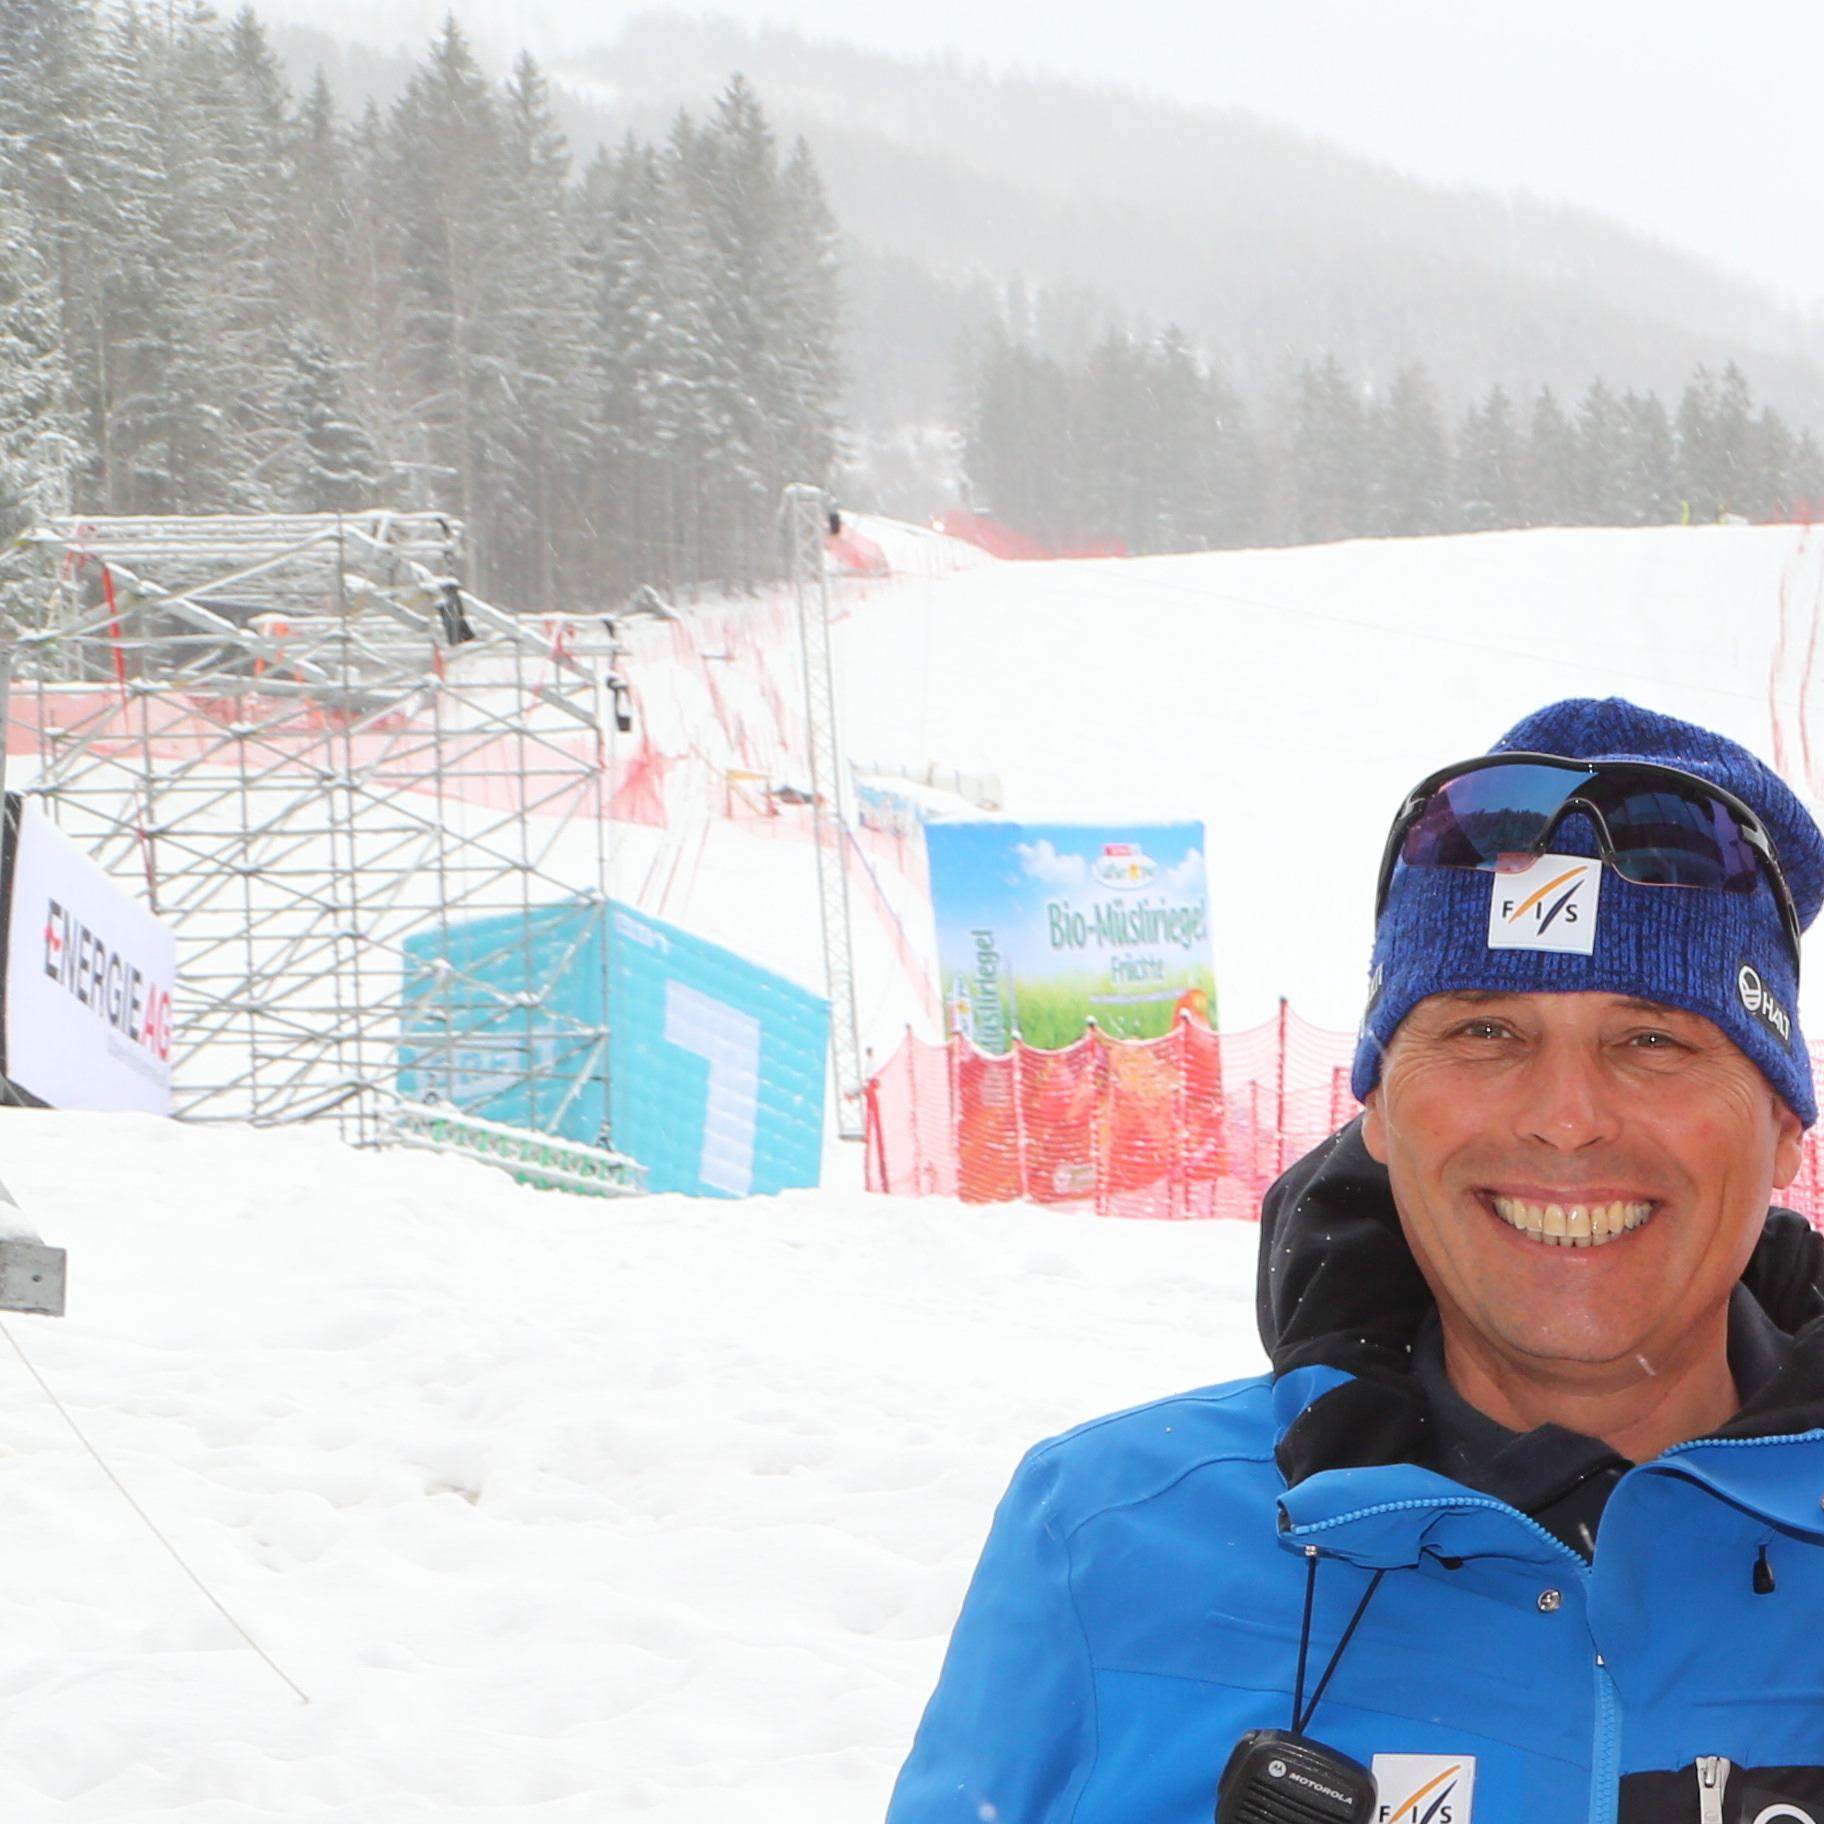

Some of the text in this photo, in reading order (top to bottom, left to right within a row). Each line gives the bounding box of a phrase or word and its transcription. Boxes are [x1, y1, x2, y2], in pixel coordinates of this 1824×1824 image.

[1502, 900, 1578, 923] FIS
[1289, 1772, 1353, 1805] MOTOROLA
[1379, 1806, 1453, 1824] FIS
